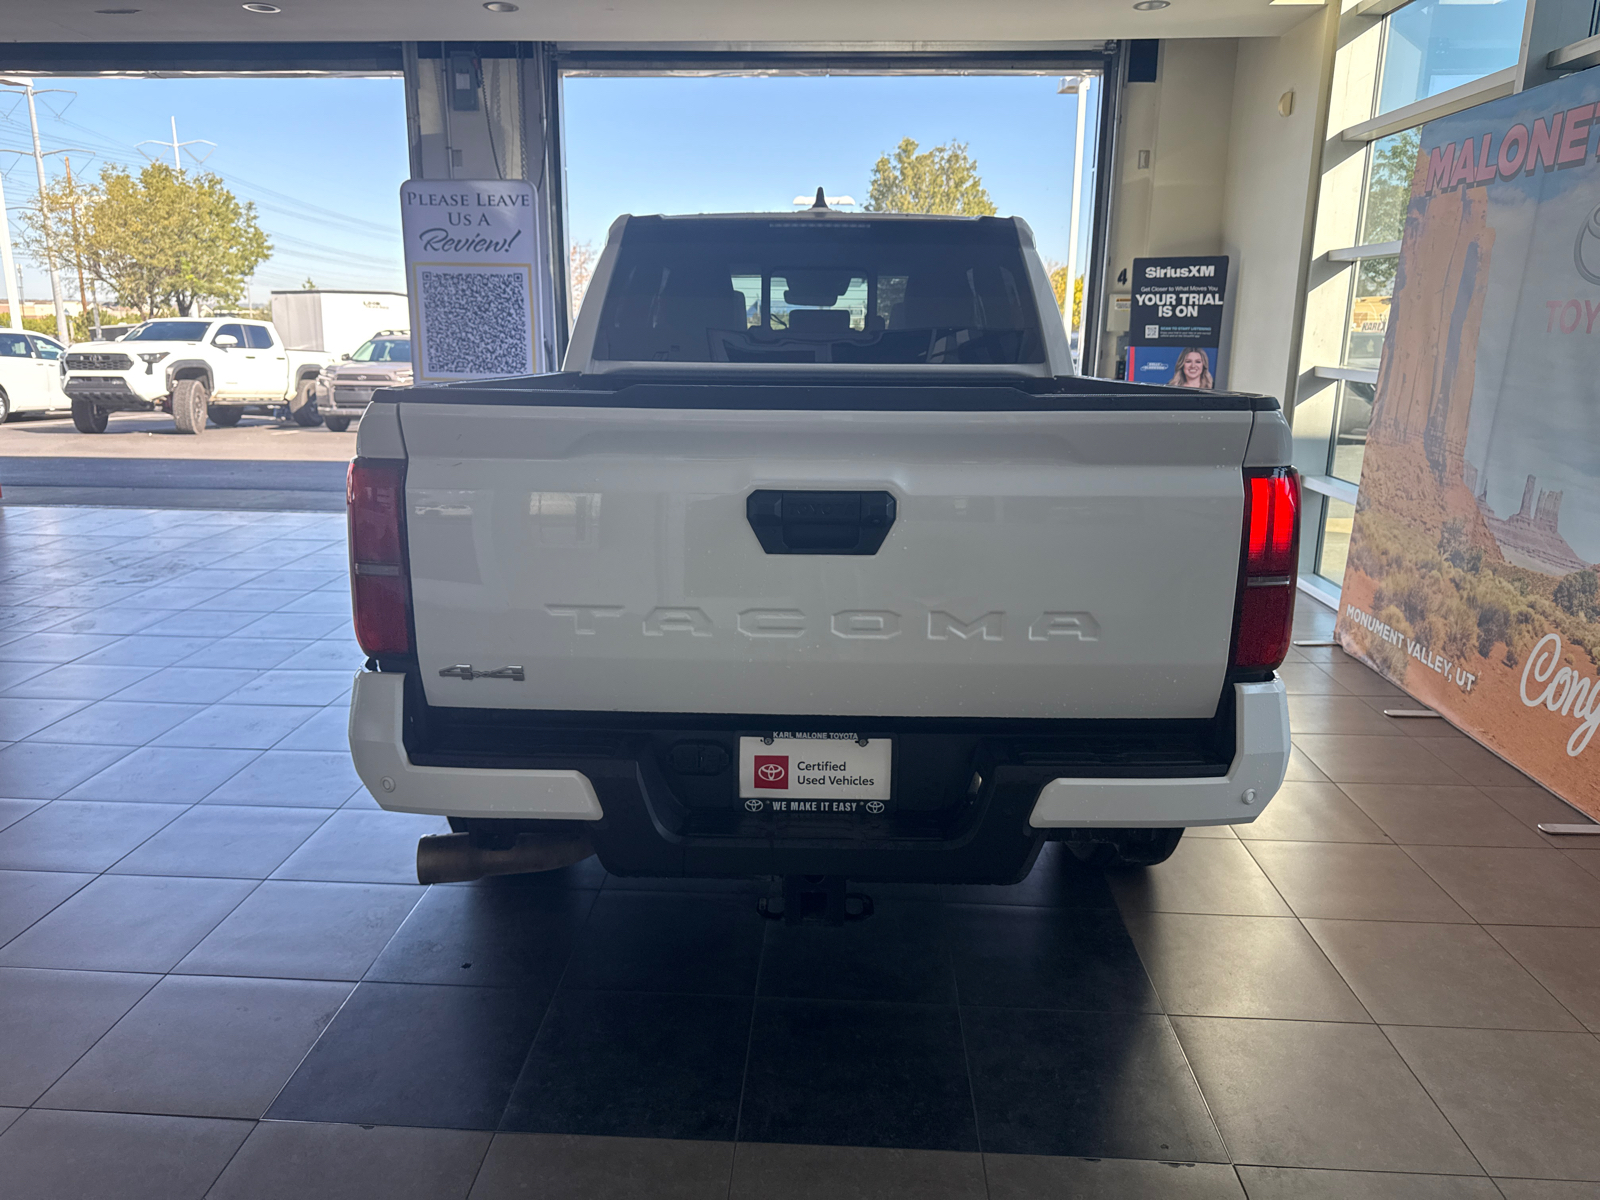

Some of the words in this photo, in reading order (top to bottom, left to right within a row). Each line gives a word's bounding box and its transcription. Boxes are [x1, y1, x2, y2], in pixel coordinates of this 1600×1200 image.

[1425, 101, 1600, 196] MALONE
[407, 191, 469, 206] PLEASE
[476, 193, 530, 207] LEAVE
[477, 213, 491, 226] A
[419, 228, 522, 253] Review!
[1117, 268, 1127, 286] 4
[1145, 265, 1215, 279] SiriusXM
[1135, 294, 1176, 306] YOUR
[1179, 293, 1224, 305] TRIAL
[1158, 306, 1172, 317] IS
[1175, 305, 1198, 317] ON
[543, 604, 1101, 641] TACOMA
[1346, 604, 1405, 648] MONUMENT
[1407, 638, 1453, 683] VALLEY,
[1456, 667, 1476, 692] UT
[772, 731, 794, 739] KARL
[795, 732, 828, 740] MALONE
[797, 761, 846, 772] Certified
[797, 775, 826, 785] Used
[828, 776, 875, 786] Vehicles
[772, 801, 786, 811] WE
[790, 802, 817, 811] MAKE
[820, 802, 829, 811] IT
[833, 802, 857, 812] EASY
